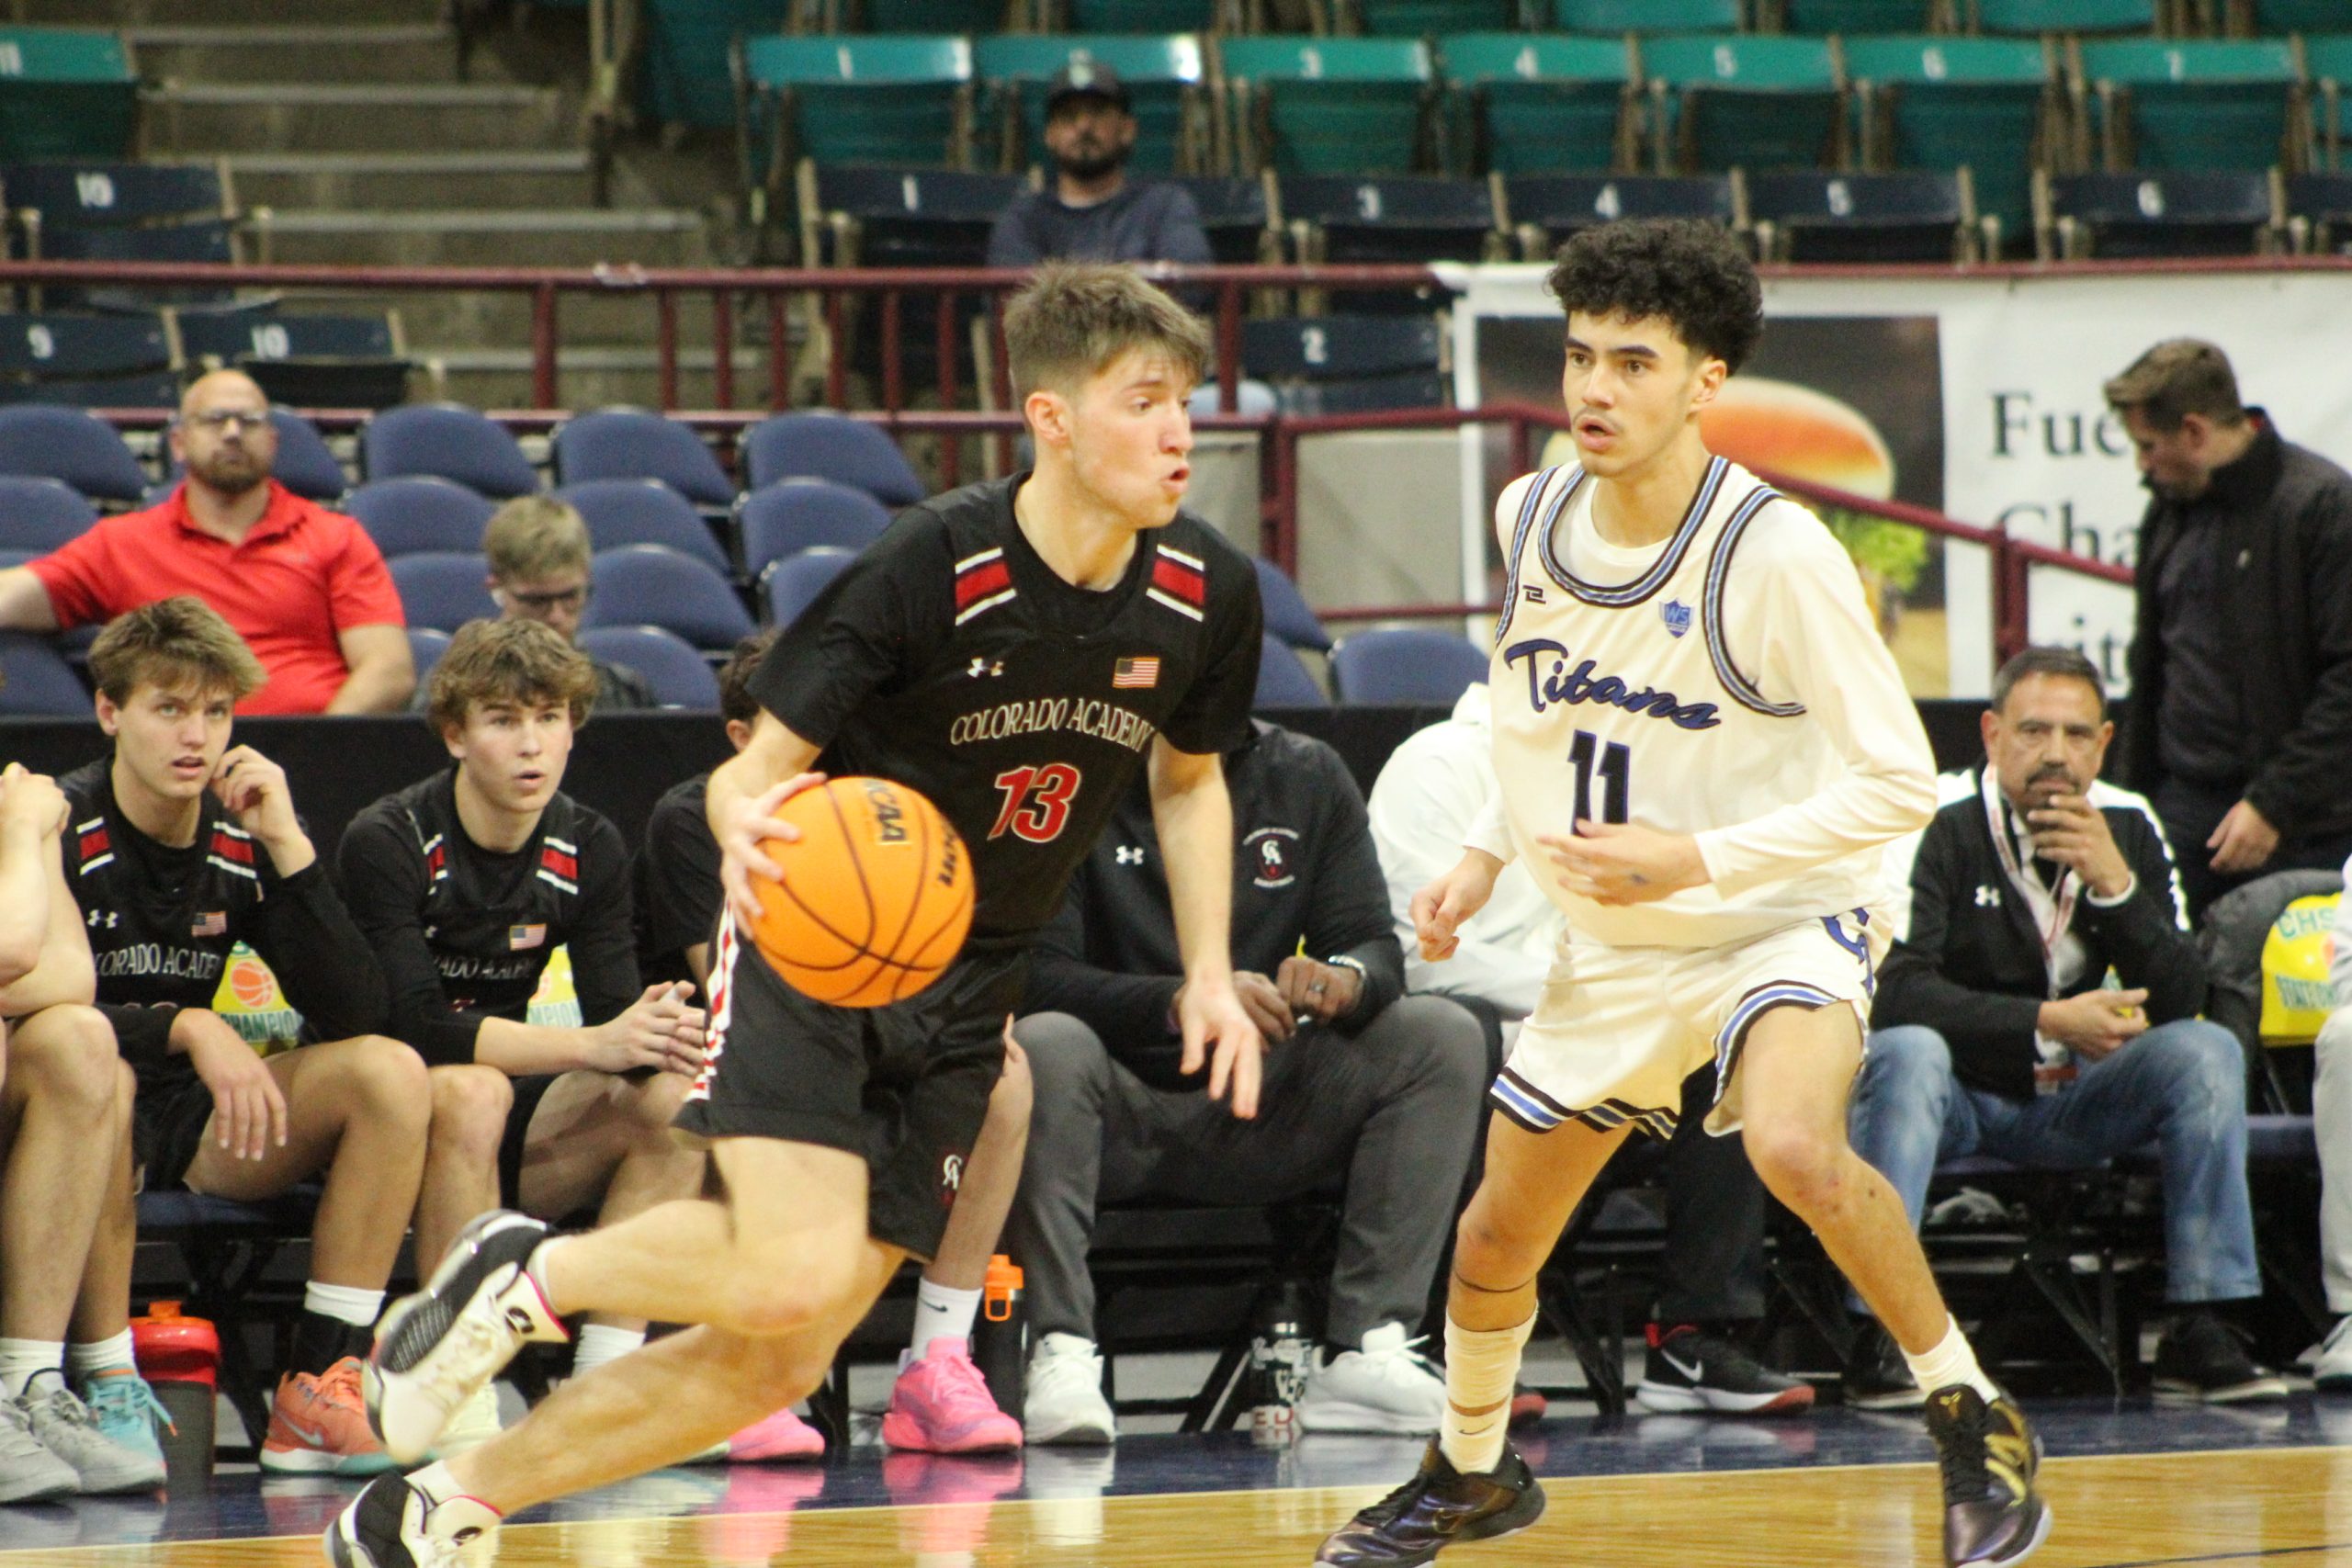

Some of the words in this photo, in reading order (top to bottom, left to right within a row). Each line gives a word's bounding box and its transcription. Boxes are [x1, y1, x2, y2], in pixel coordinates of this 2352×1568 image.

[75, 172, 114, 208] 10
[251, 324, 289, 359] 10
[1504, 638, 1722, 730] Titans
[950, 698, 1069, 747] COLORADO
[1067, 697, 1157, 753] ACADEMY
[987, 762, 1082, 843] 13
[1567, 728, 1631, 836] 11
